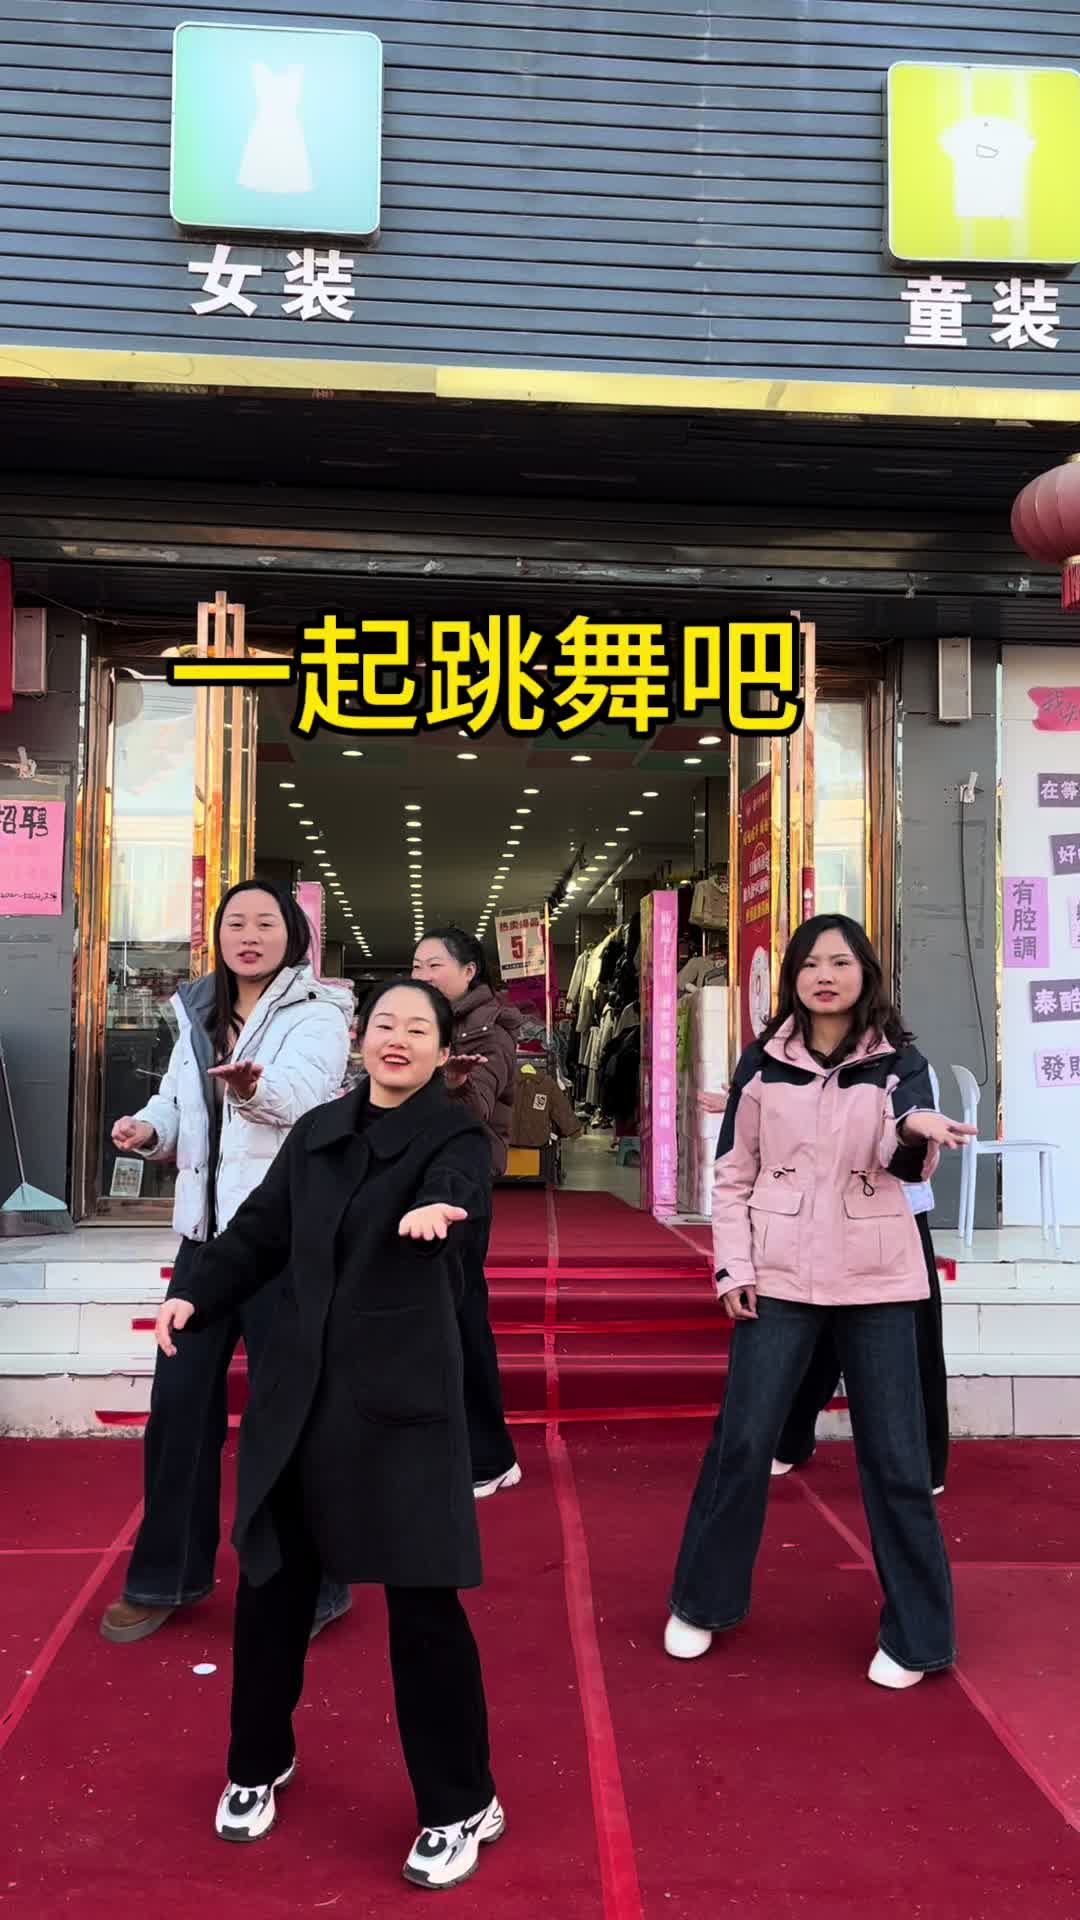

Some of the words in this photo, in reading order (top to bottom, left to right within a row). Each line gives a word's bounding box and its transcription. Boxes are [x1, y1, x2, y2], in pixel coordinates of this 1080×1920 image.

[188, 244, 355, 321] 女装
[901, 275, 1060, 349] 童装
[1057, 844, 1080, 864] 好
[1012, 879, 1037, 960] 有腔調
